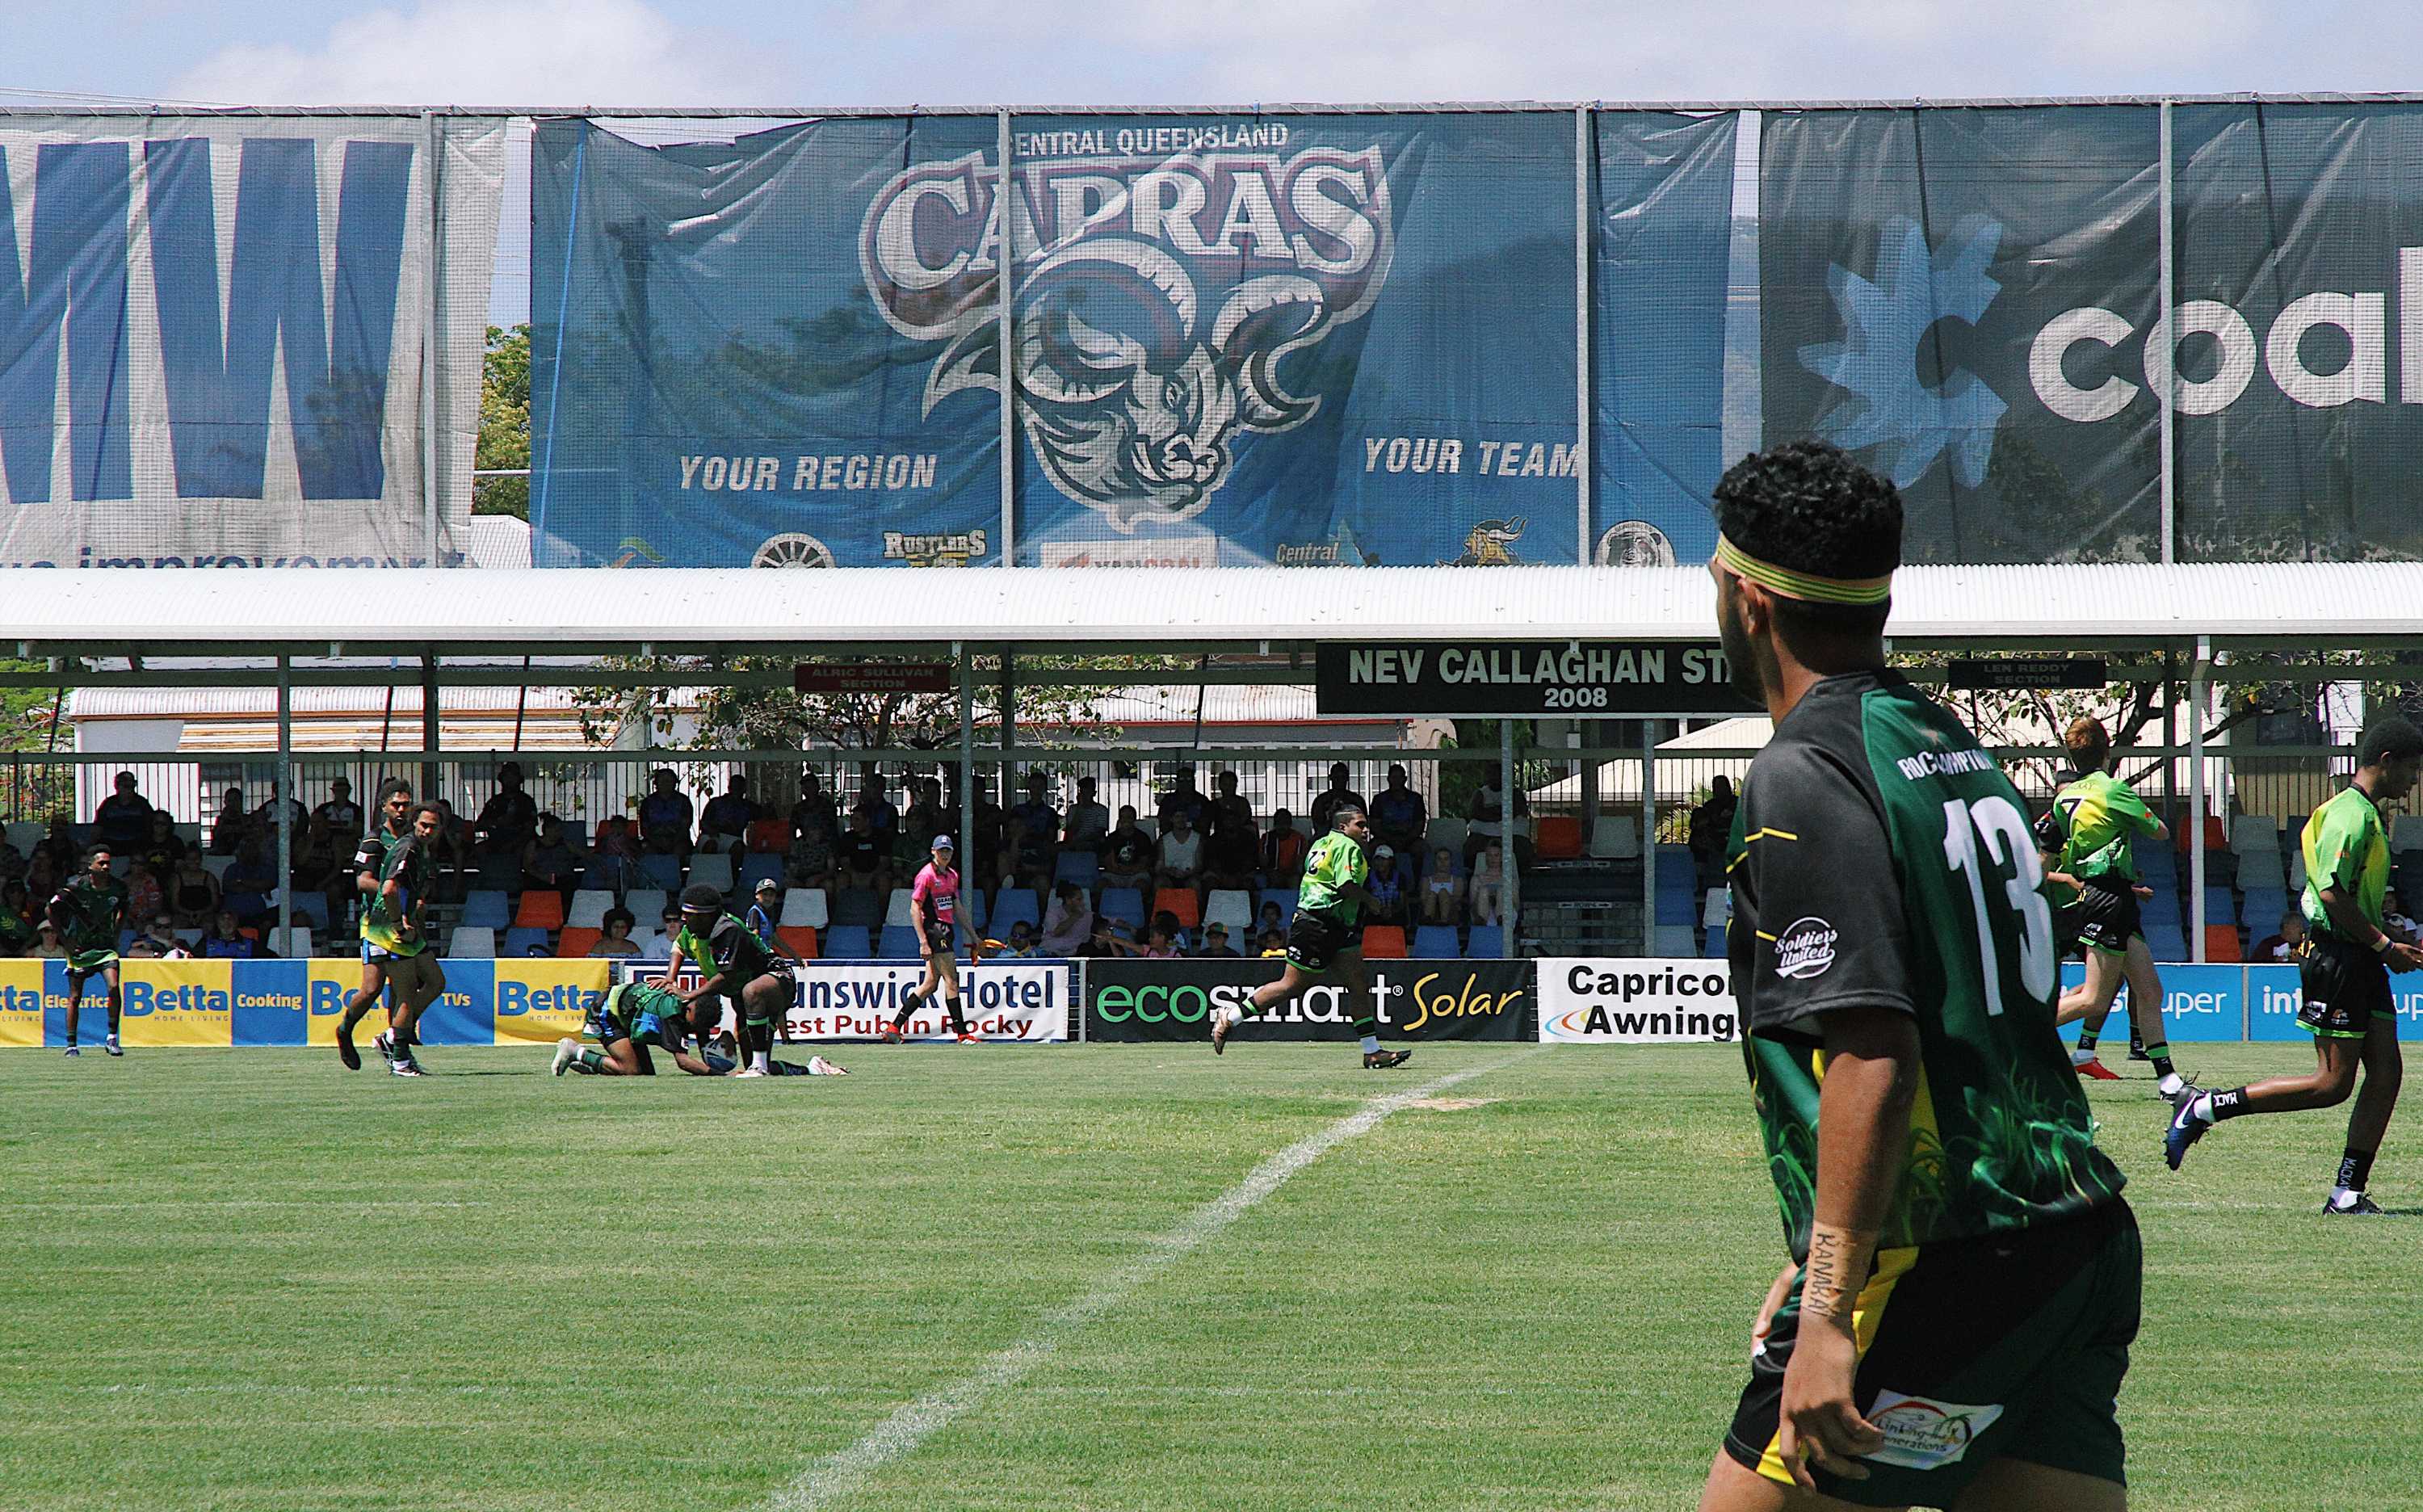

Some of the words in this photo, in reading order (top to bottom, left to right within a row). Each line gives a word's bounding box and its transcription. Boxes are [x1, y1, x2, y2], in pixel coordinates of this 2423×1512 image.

[1010, 126, 1111, 157] ENTRAL
[1117, 122, 1290, 156] QUEENSLAND
[871, 153, 1381, 292] CAPRAS
[1364, 437, 1463, 474] YOUR
[1479, 440, 1579, 477] TEAM
[679, 456, 779, 491] YOUR
[792, 453, 938, 492] REGION
[1276, 542, 1339, 563] Central
[813, 668, 856, 678] ALRIC
[863, 667, 934, 678] SULLIVAN
[1349, 649, 1424, 684] NEV
[1439, 649, 1665, 684] CALLAGHAN
[1682, 649, 1731, 684] ST
[1983, 664, 2012, 673] LEN
[2018, 664, 2070, 673] REDDY
[840, 679, 905, 688] SECTION
[1993, 675, 2060, 684] SECTION
[1544, 688, 1608, 708] 2008
[2060, 797, 2085, 842] 7
[1942, 795, 2056, 1017] 13
[1774, 929, 1838, 954] Soldiers
[1780, 942, 1831, 967] United
[958, 970, 1053, 1009] Hotel
[1568, 964, 1735, 1002] Caprico
[123, 981, 229, 1017] Betta
[237, 993, 303, 1010] Cooking
[441, 993, 472, 1007] TVs
[1403, 972, 1523, 1031] Solar
[527, 1014, 558, 1023] HOME
[783, 1016, 825, 1035] est
[834, 1014, 891, 1035] Pub
